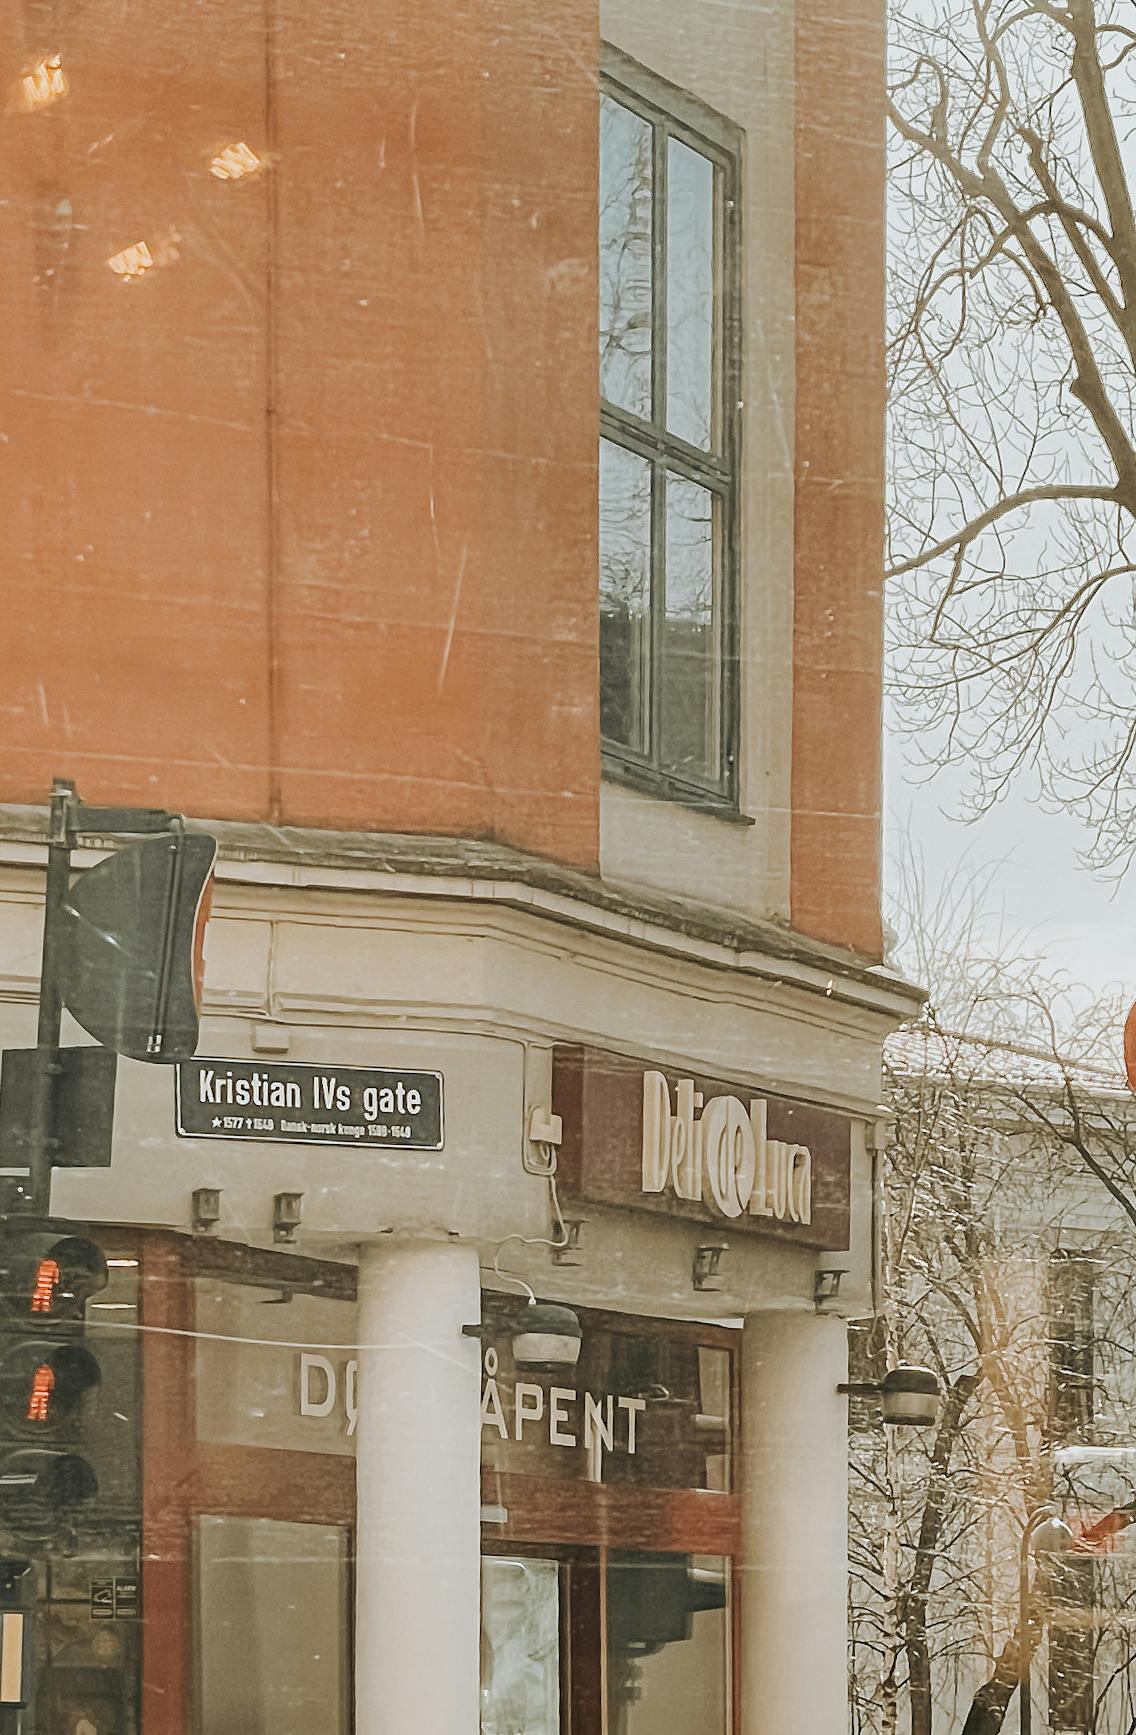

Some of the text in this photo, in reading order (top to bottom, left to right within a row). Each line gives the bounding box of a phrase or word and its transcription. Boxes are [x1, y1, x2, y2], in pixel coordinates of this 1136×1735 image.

[199, 1069, 422, 1121] Kristian IVs gate
